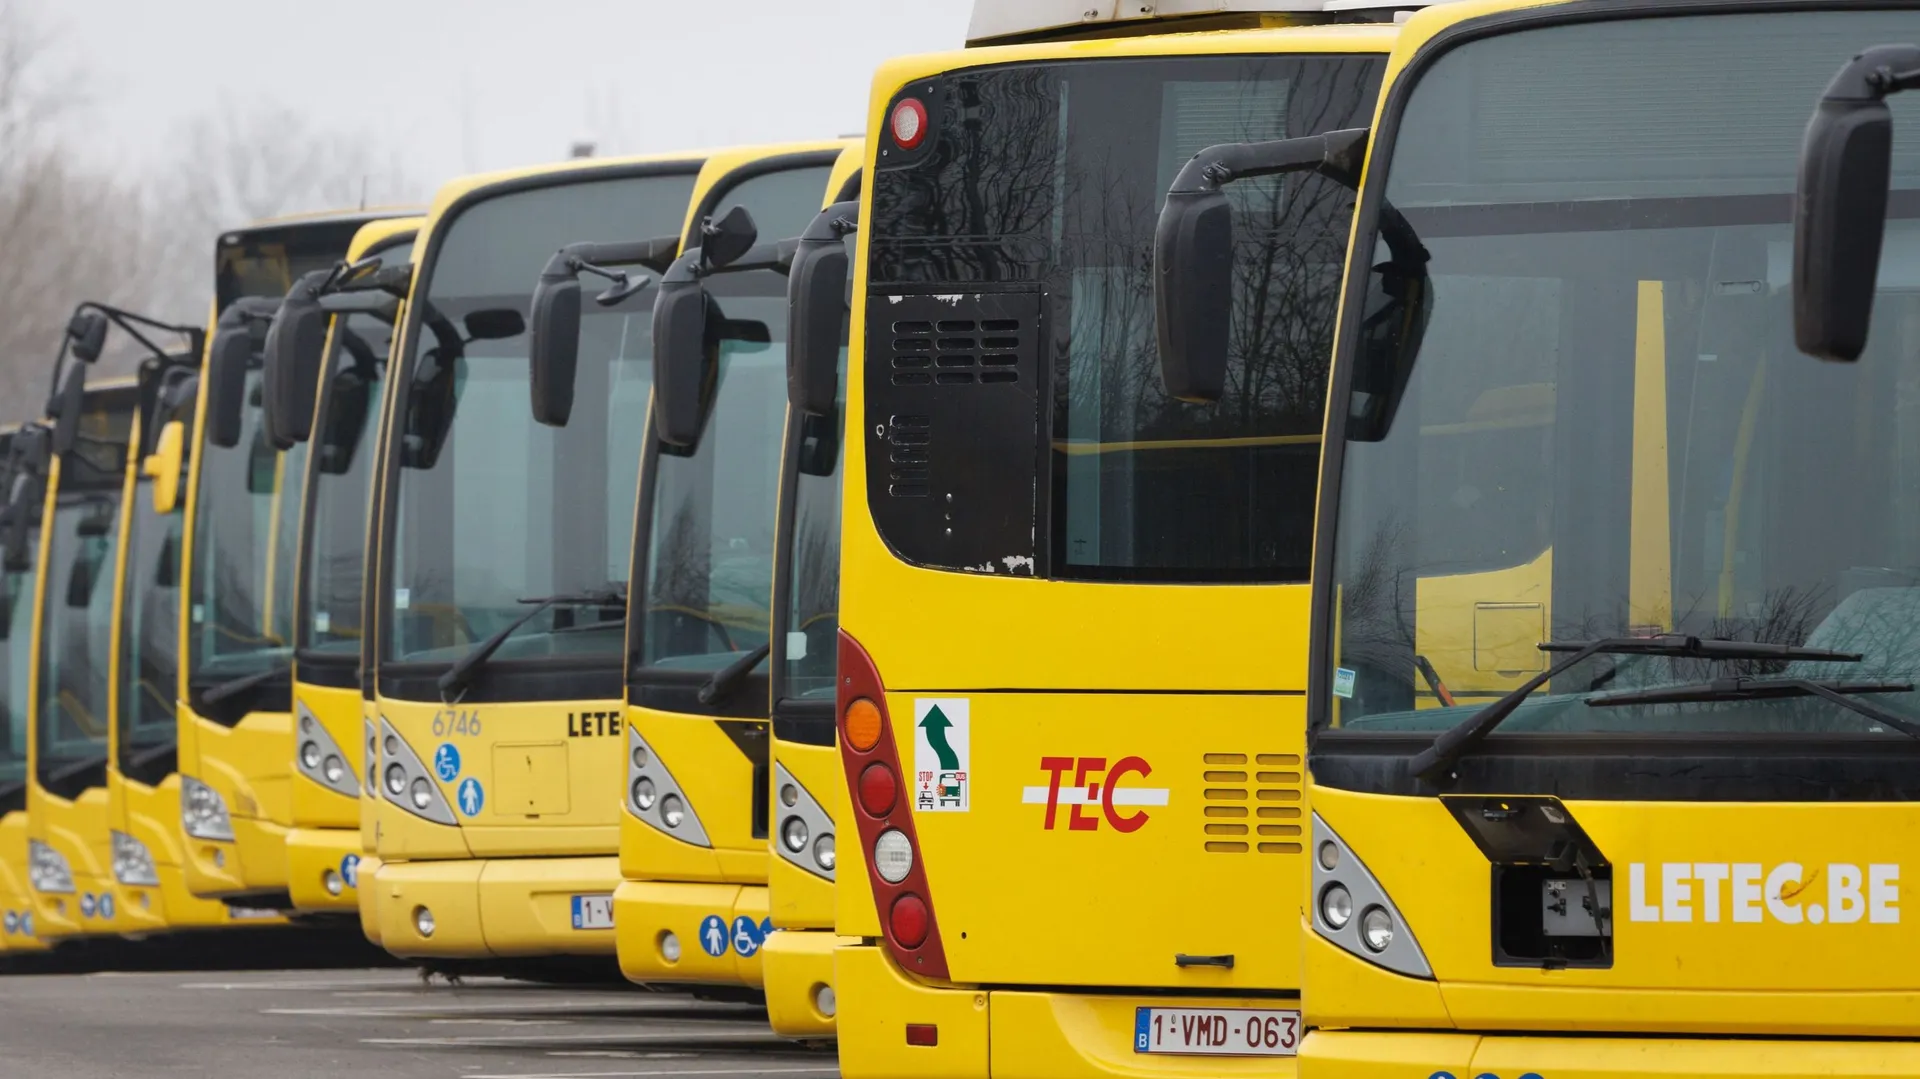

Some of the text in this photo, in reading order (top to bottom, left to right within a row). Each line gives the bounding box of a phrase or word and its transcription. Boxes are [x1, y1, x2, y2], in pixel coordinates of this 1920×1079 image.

[432, 710, 481, 737] 6746
[568, 711, 624, 737] LETE
[918, 771, 934, 782] STOP
[1040, 756, 1152, 833] TEC
[1629, 862, 1900, 924] LETEC.BE
[1138, 1014, 1297, 1049] B 1-VMD-063
